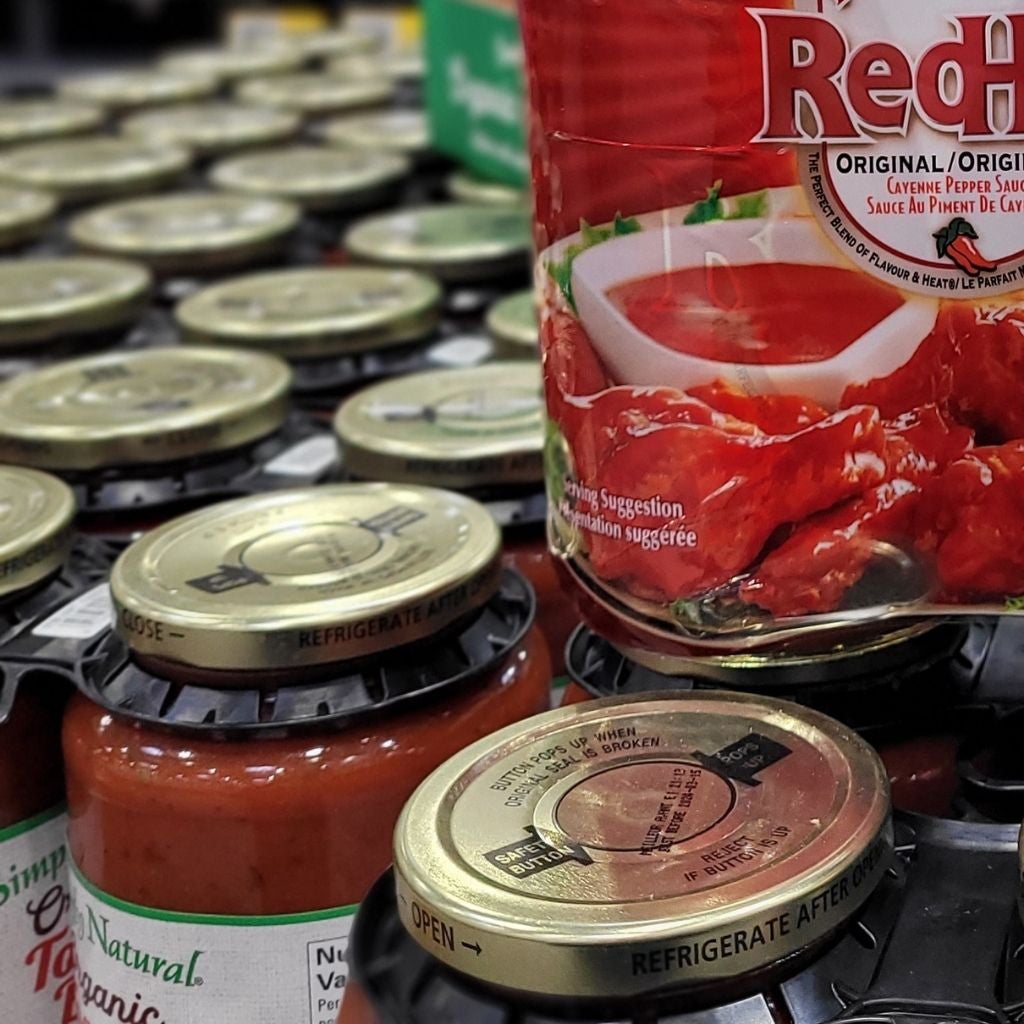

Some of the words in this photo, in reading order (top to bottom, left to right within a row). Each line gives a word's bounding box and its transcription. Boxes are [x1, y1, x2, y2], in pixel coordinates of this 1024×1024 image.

[808, 152, 819, 173] THE
[811, 175, 835, 218] PERFECT
[887, 176, 941, 194] CAYENNE
[946, 176, 991, 194] PEPPER
[867, 196, 904, 214] SAUCE
[909, 196, 924, 214] AU
[929, 195, 976, 214] PIMENT
[980, 195, 996, 213] DE
[830, 217, 855, 247] BLEND
[856, 244, 870, 257] OF
[869, 252, 910, 280] FLAVOUR
[912, 272, 919, 283] &
[977, 271, 1017, 288] PARFAIT
[962, 278, 975, 289] LE
[600, 488, 683, 520] Suggestion
[299, 608, 422, 650] REFRIGERATE
[490, 762, 535, 791] BUTTON
[530, 745, 567, 765] POPS
[570, 736, 588, 749] UP
[595, 727, 636, 743] WHEN
[545, 756, 581, 774] SEAL
[582, 748, 598, 759] IS
[602, 737, 661, 753] BROKEN
[508, 845, 575, 874] BUTTON
[684, 871, 698, 882] IF
[704, 848, 760, 876] BUTTON
[760, 837, 777, 848] IS
[772, 826, 792, 837] UP
[701, 835, 753, 863] REJECT
[411, 907, 455, 953] OPEN
[631, 912, 790, 976] REFRIGERATE
[797, 878, 849, 929] AFTER
